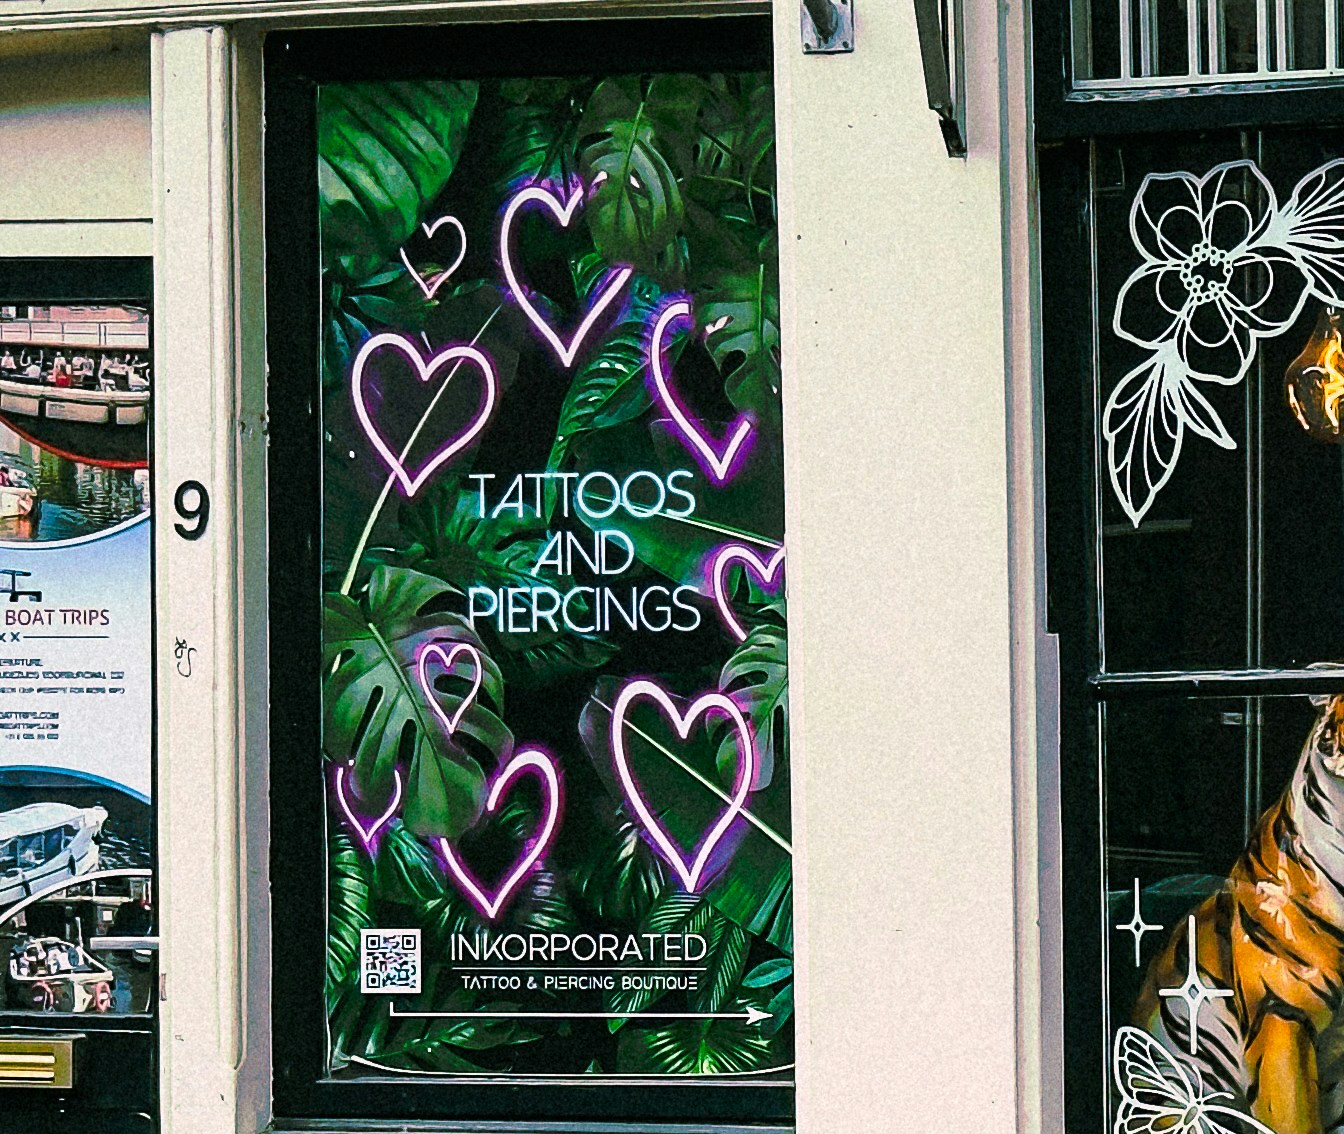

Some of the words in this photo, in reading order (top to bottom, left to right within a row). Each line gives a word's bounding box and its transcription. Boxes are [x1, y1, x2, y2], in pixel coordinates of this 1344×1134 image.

[174, 480, 210, 541] 9
[469, 470, 696, 519] TATTOOS
[532, 530, 634, 576] AND
[5, 609, 55, 626] BOAT
[59, 608, 110, 626] TRIPS
[469, 585, 702, 633] PIERCINGS
[451, 933, 707, 962] INKORPORATED
[462, 976, 521, 990] TATTOO
[527, 977, 538, 990] &
[545, 976, 615, 990] PIERCING
[622, 976, 699, 990] BOUTIQUE
